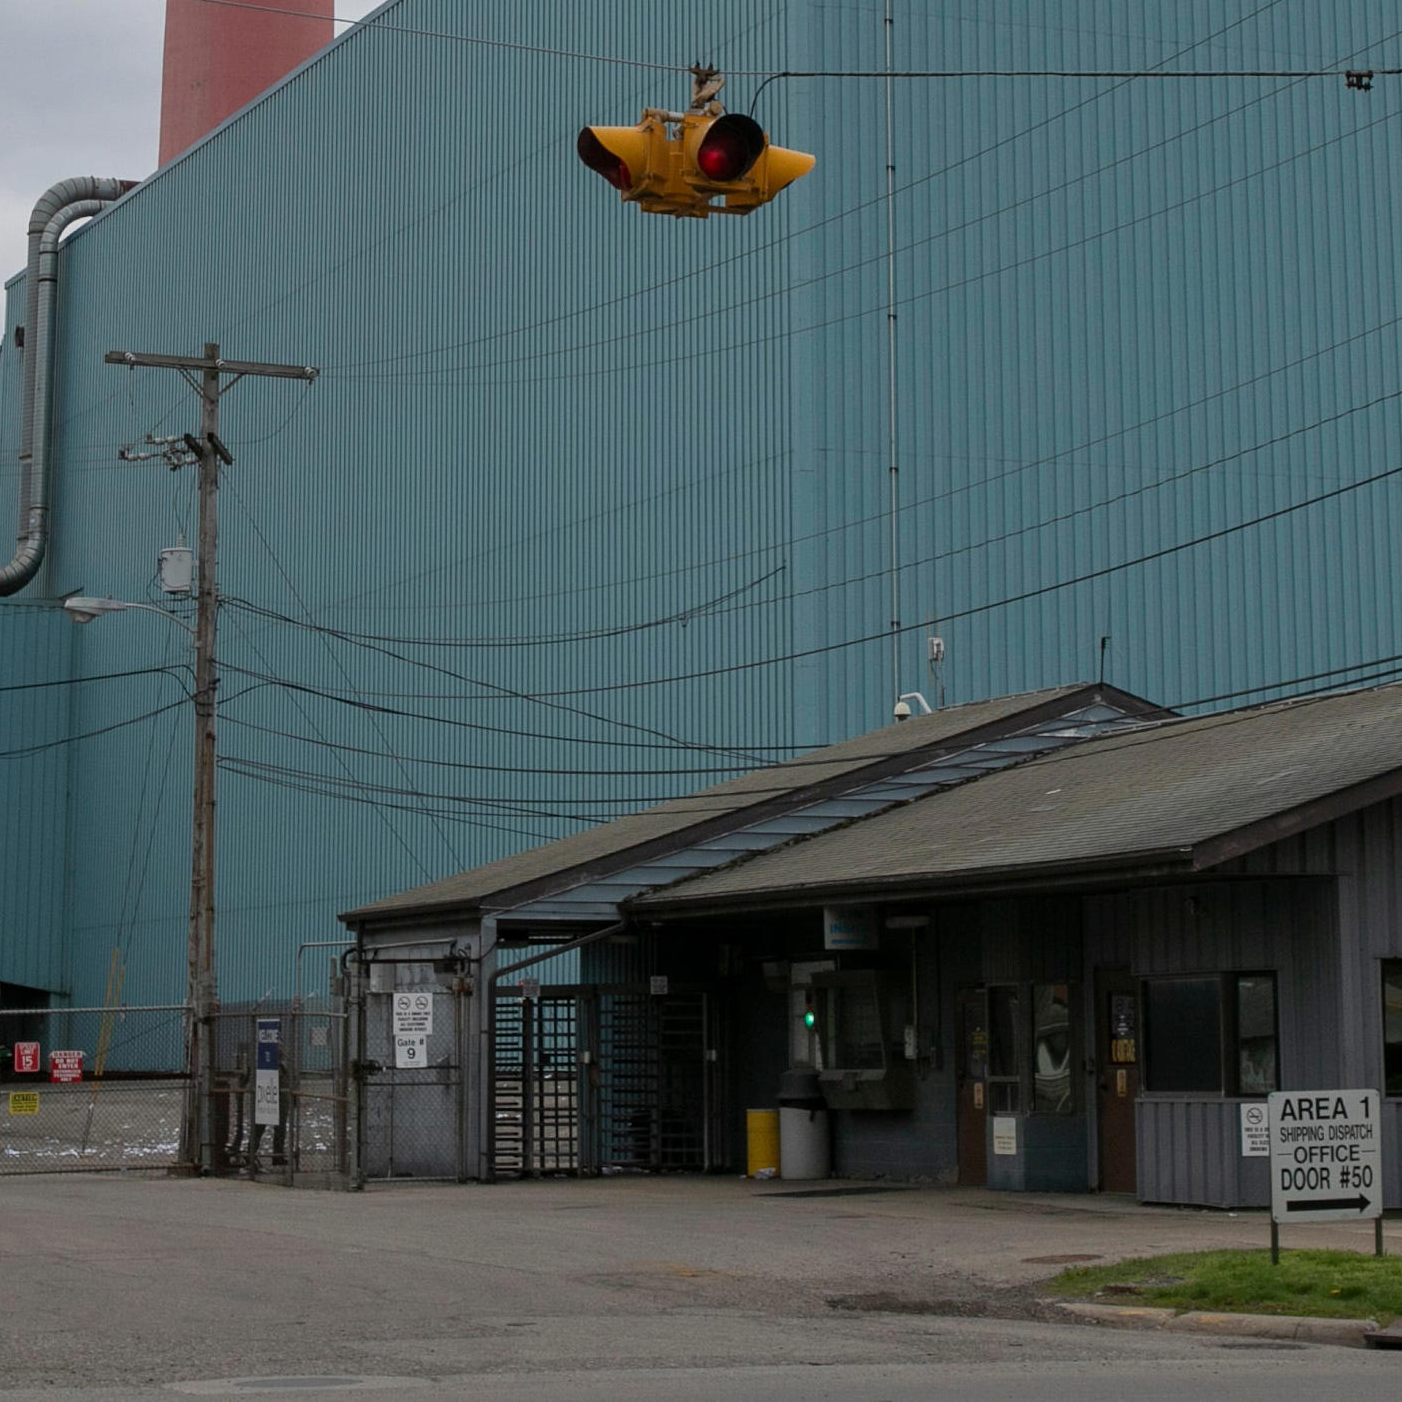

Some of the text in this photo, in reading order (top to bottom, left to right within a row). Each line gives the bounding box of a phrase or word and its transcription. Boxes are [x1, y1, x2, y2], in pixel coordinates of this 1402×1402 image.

[398, 1038, 415, 1046] Gate
[22, 1055, 33, 1067] 15
[407, 1047, 416, 1059] 9
[1280, 1096, 1370, 1121] AREA 1
[1280, 1124, 1373, 1143] SHIPPING DISPATCH
[1293, 1144, 1361, 1164] OFFICE
[1281, 1165, 1373, 1191] DOOR #50
